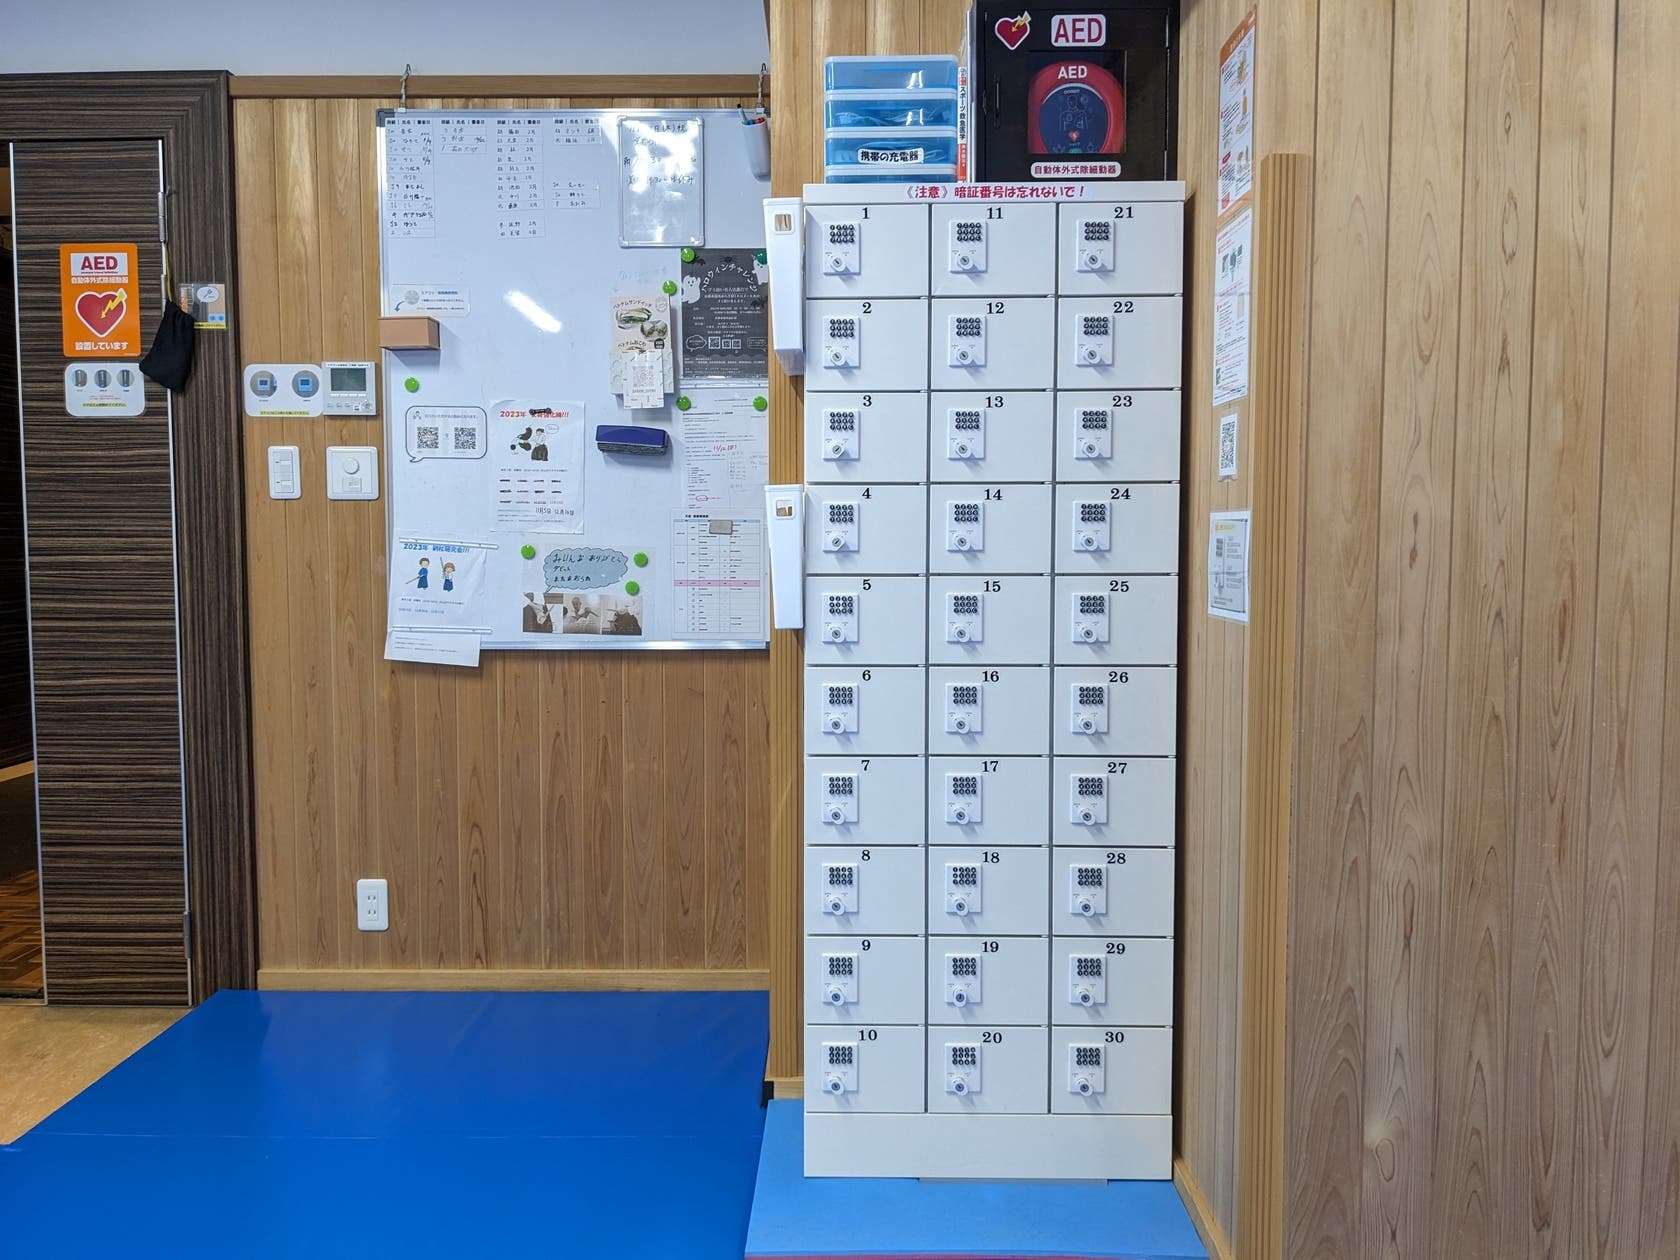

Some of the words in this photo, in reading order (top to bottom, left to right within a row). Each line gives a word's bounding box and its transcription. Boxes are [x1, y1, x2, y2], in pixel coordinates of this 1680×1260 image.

[1053, 18, 1103, 43] AED
[1058, 66, 1088, 79] AED
[860, 150, 921, 162] 携帯の充電器
[1034, 165, 1117, 175] 自動体外式除細動器
[861, 207, 869, 219] 1
[986, 207, 1002, 219] 11
[1114, 206, 1134, 218] 21
[81, 255, 118, 270] AED
[862, 302, 871, 313] 2
[985, 301, 1004, 314] 12
[1113, 301, 1133, 313] 22
[75, 342, 128, 350] 設置しています
[863, 395, 871, 406] 3
[985, 396, 1003, 407] 13
[1112, 395, 1132, 407] 23
[861, 488, 871, 499] 4
[983, 489, 1001, 500] 14
[1110, 488, 1130, 500] 24
[403, 543, 428, 551] 2023年
[862, 579, 871, 590] 5
[982, 581, 1000, 592] 15
[1109, 580, 1129, 592] 25
[862, 670, 871, 681] 6
[981, 671, 999, 682] 16
[1108, 671, 1128, 683] 26
[861, 760, 870, 771] 7
[981, 761, 999, 772] 17
[1107, 762, 1127, 774] 27
[861, 850, 870, 861] 8
[981, 852, 999, 863] 18
[1106, 852, 1126, 864] 28
[861, 940, 870, 951] 9
[981, 942, 999, 952] 19
[1105, 943, 1125, 954] 29
[858, 1030, 877, 1040] 10
[981, 1032, 1002, 1043] 20
[1104, 1032, 1124, 1043] 30
